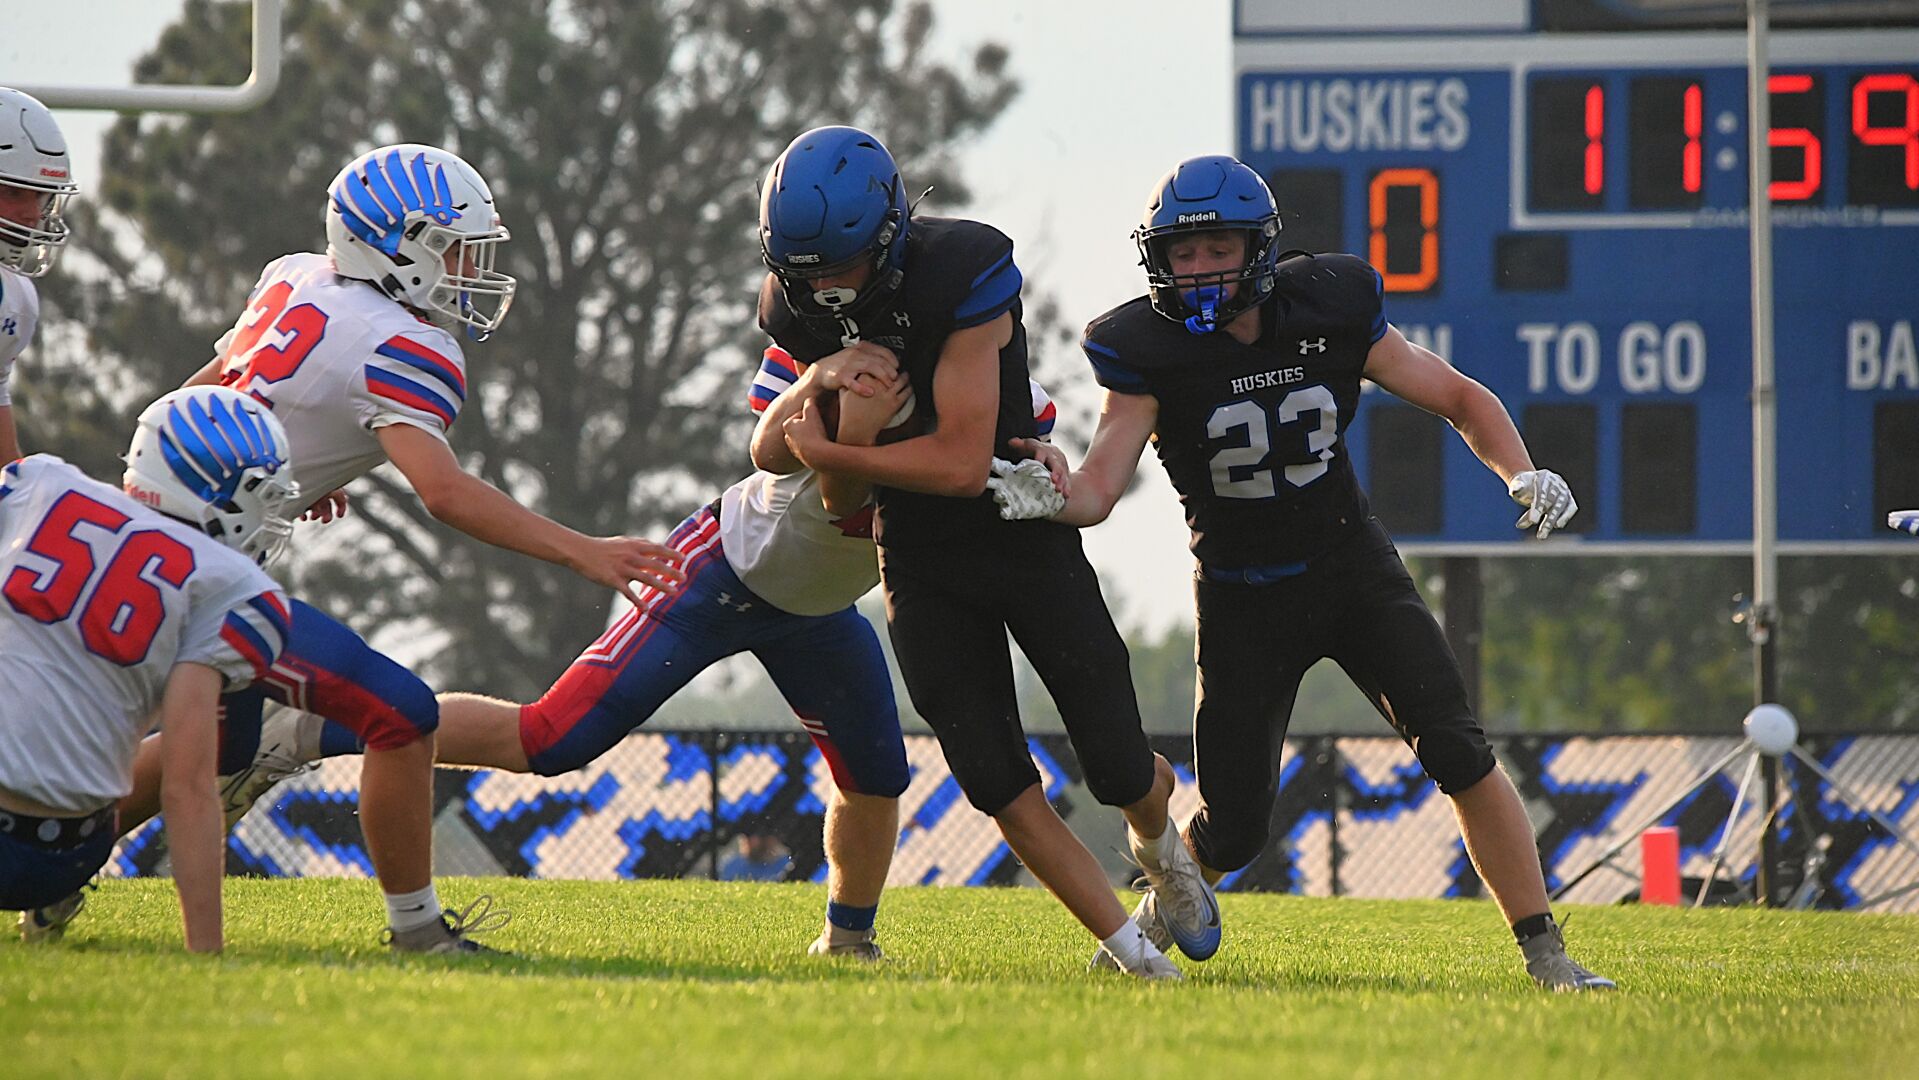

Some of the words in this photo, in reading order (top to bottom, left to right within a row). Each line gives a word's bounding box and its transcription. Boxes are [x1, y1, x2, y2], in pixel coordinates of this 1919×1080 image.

[1252, 80, 1469, 151] HUSKIES
[1178, 212, 1216, 224] Riddell
[1369, 168, 1438, 292] 0
[220, 279, 330, 410] 22
[1230, 366, 1304, 394] HUSKIES
[1516, 321, 1600, 394] TO
[1617, 320, 1707, 394] GO
[1206, 384, 1338, 499] 23
[2, 489, 196, 667] 56
